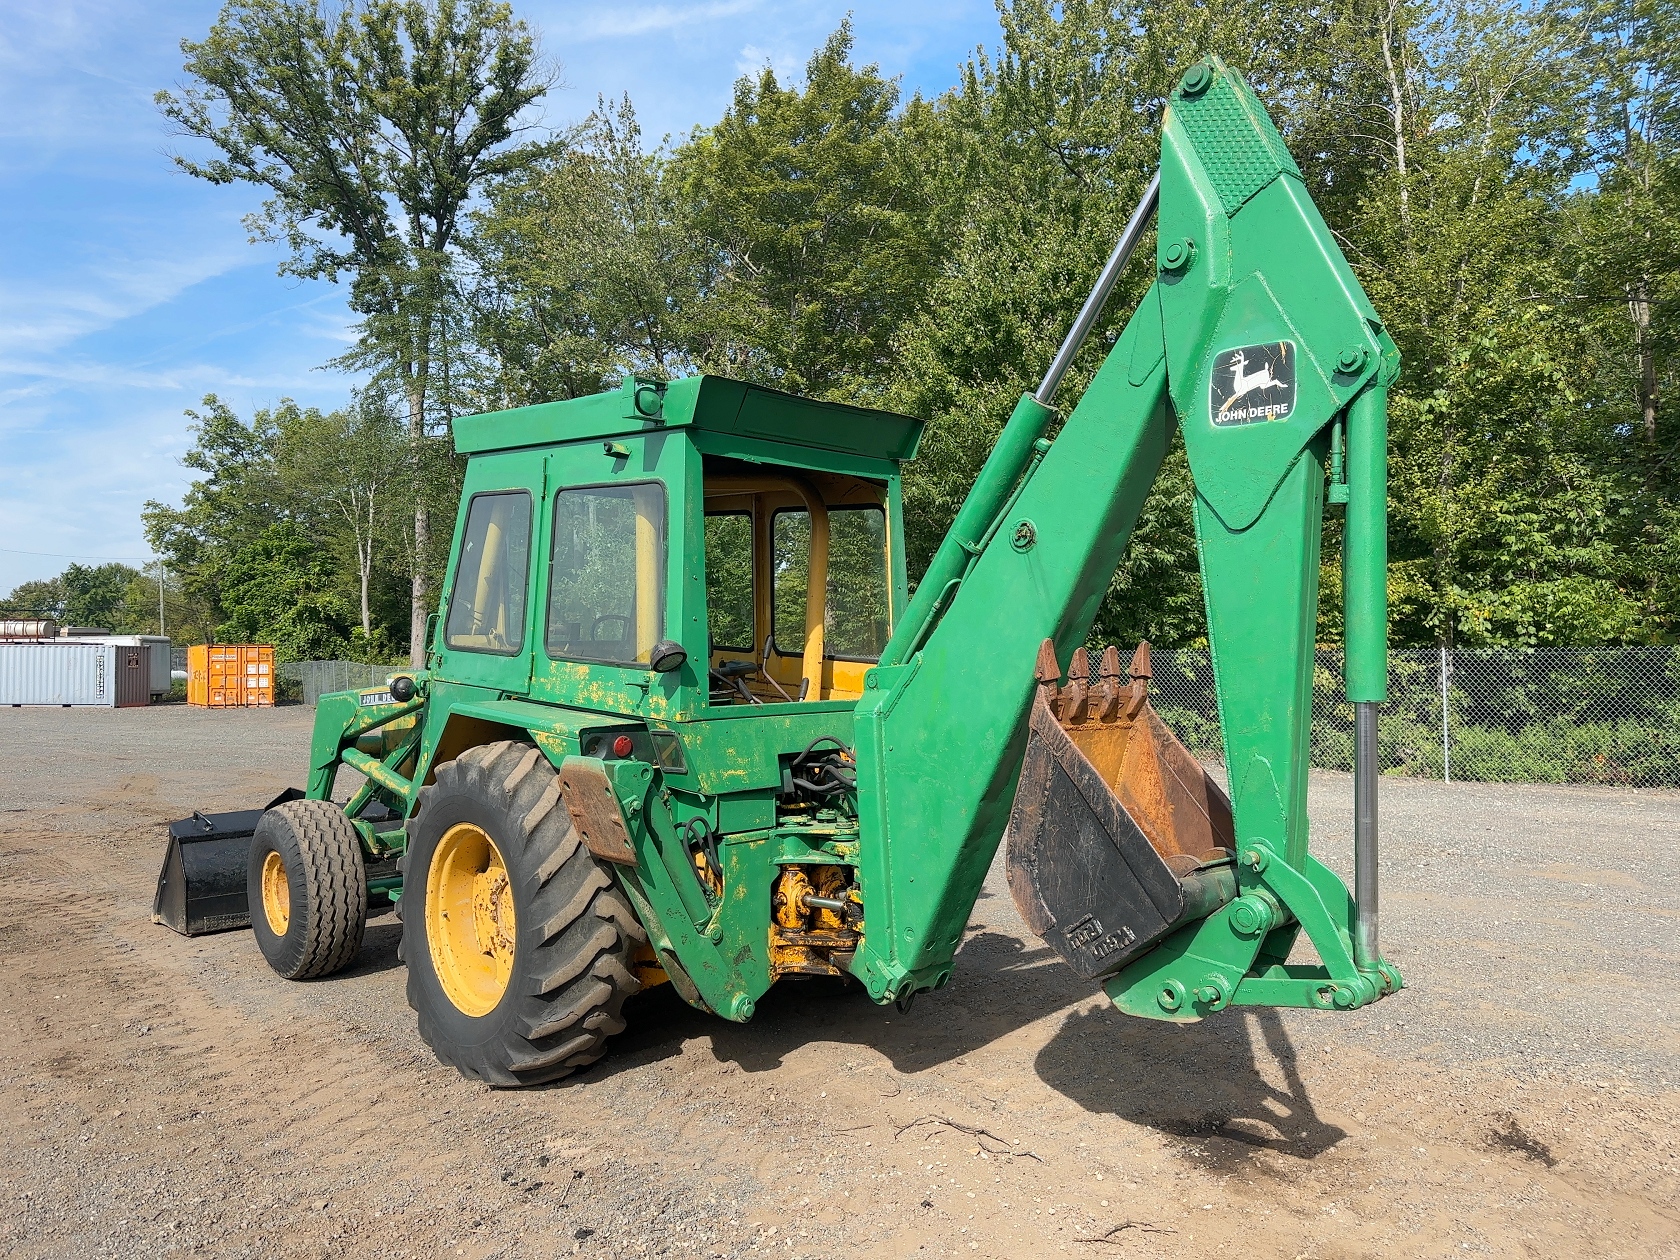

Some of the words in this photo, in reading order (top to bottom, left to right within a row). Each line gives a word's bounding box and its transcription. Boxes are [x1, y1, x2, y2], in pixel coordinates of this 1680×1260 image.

[1215, 409, 1247, 423] JOHN
[1250, 403, 1289, 417] DEERE
[363, 694, 379, 704] JOHN
